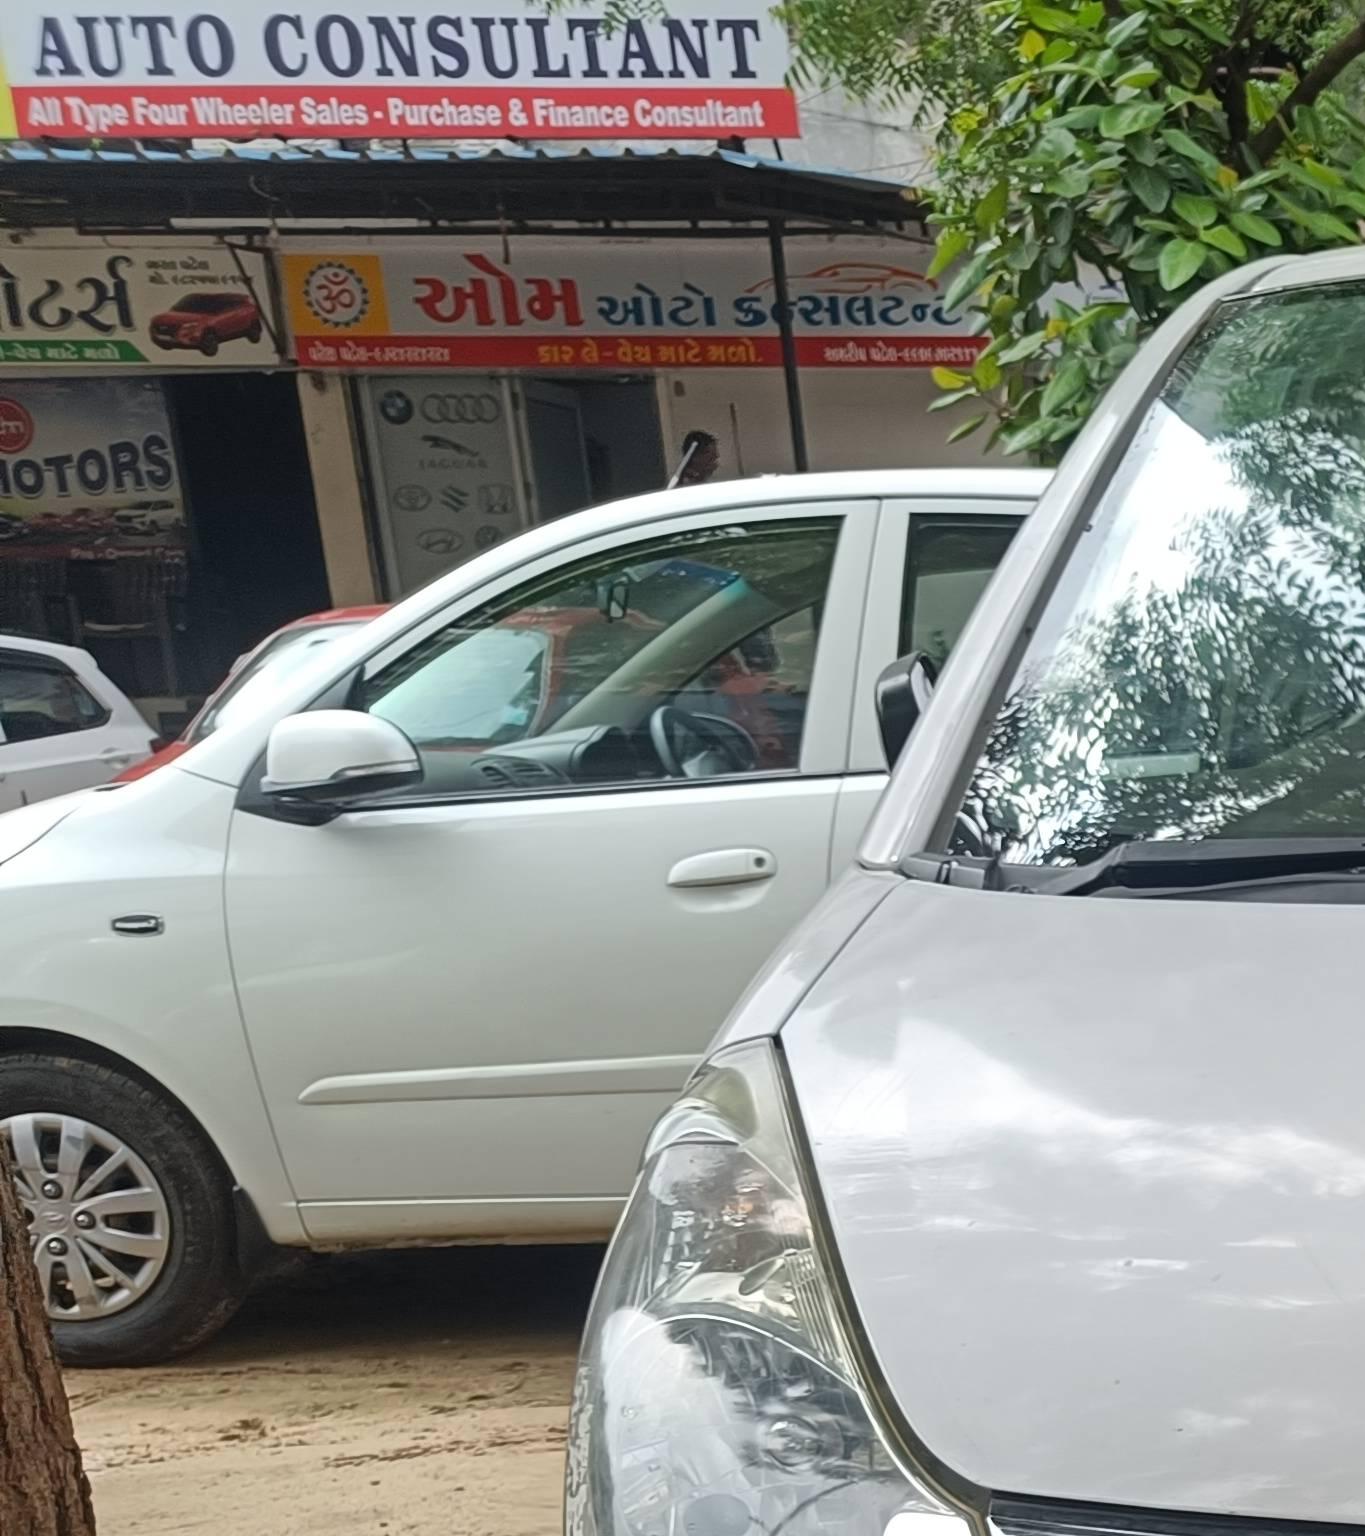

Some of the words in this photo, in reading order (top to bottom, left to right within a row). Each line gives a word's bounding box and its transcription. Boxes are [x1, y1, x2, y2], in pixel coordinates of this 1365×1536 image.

[34, 14, 236, 78] AUTO
[263, 14, 761, 79] CONSULTANT
[28, 97, 63, 126] All
[64, 97, 129, 133] Type
[131, 97, 189, 126] Four
[191, 97, 295, 126] Wheeler
[300, 97, 368, 126] Sales
[387, 98, 502, 127] Purchase
[508, 98, 528, 127] &
[532, 99, 629, 127] Finance
[634, 99, 765, 128] Consultant
[0, 255, 136, 333] ોટર્સ
[412, 253, 585, 327] ઓમ
[595, 282, 717, 326] ઓટો
